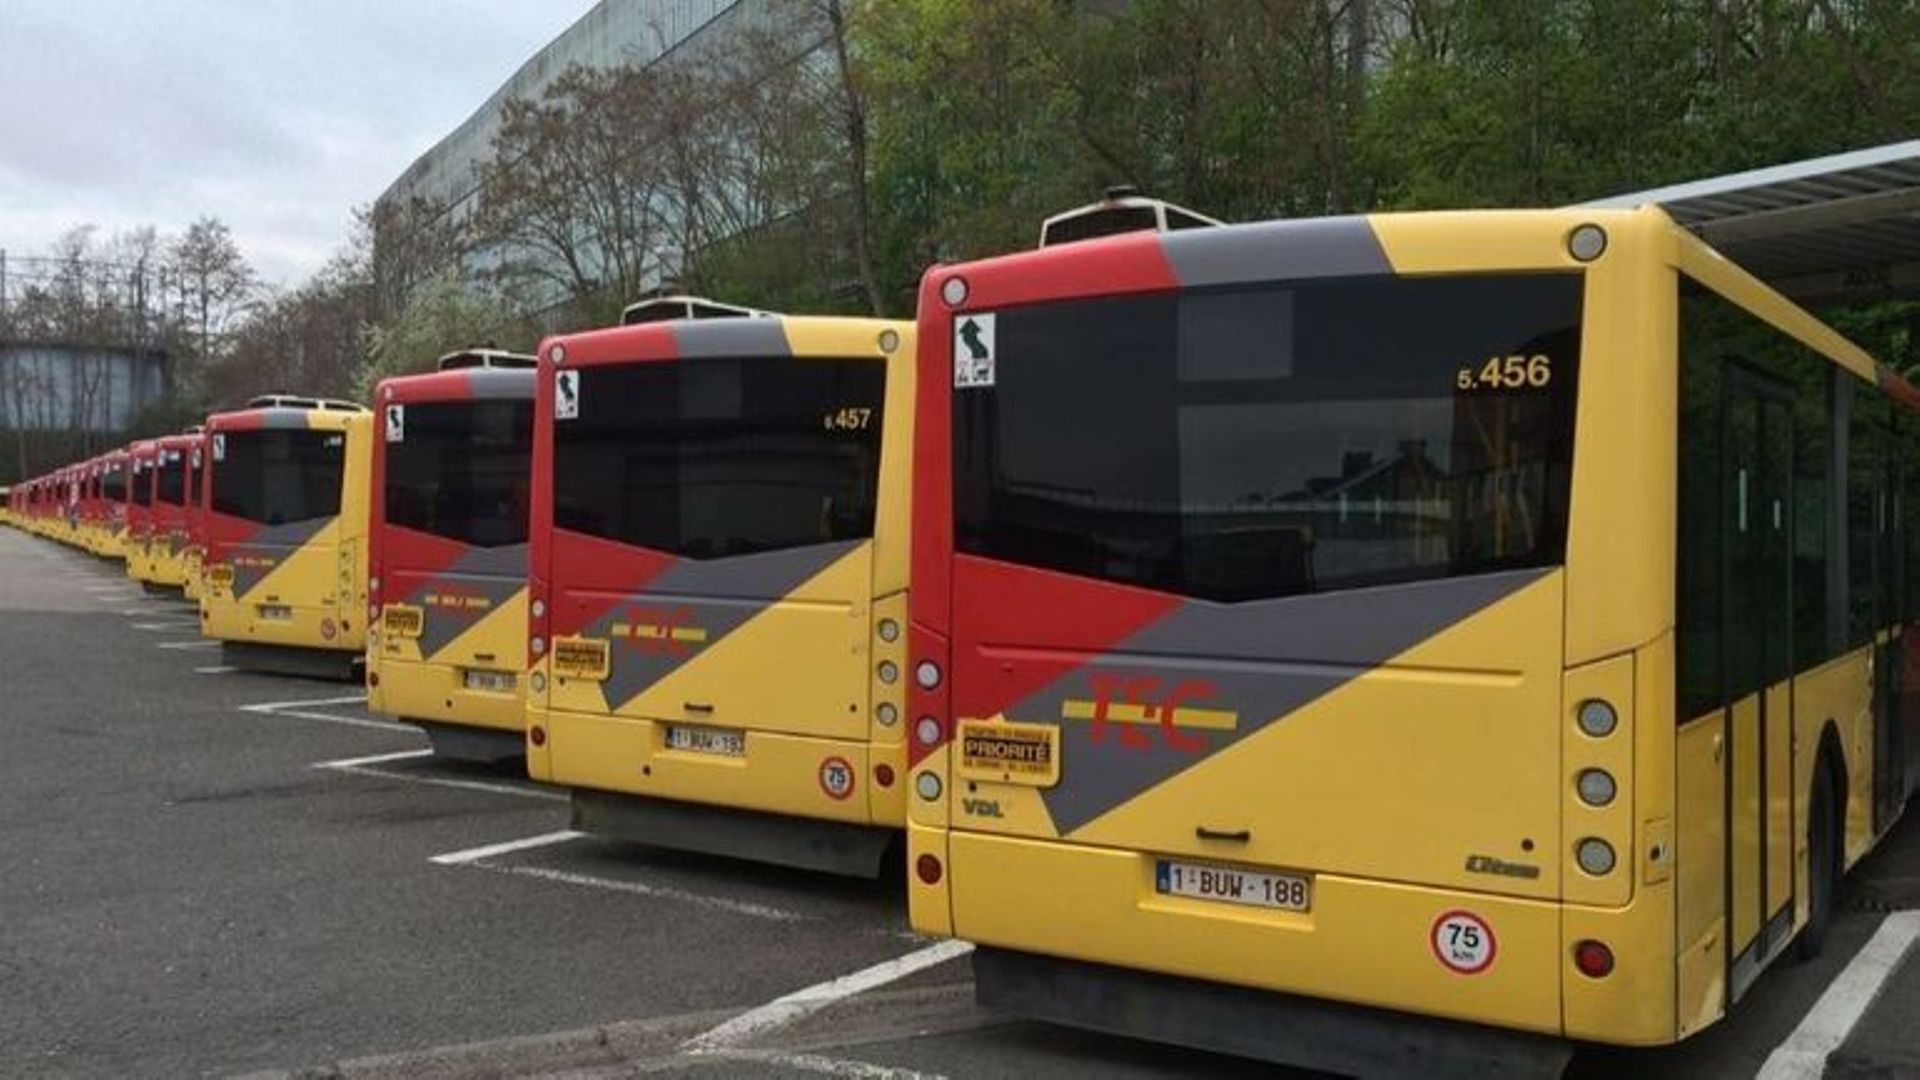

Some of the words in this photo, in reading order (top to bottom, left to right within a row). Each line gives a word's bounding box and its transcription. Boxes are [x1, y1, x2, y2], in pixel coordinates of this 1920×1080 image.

[1457, 355, 1551, 389] 5.456
[1087, 674, 1220, 752] TEC
[966, 740, 1048, 761] PRIORITÉ
[1447, 923, 1479, 948] 75
[1452, 949, 1476, 961] km
